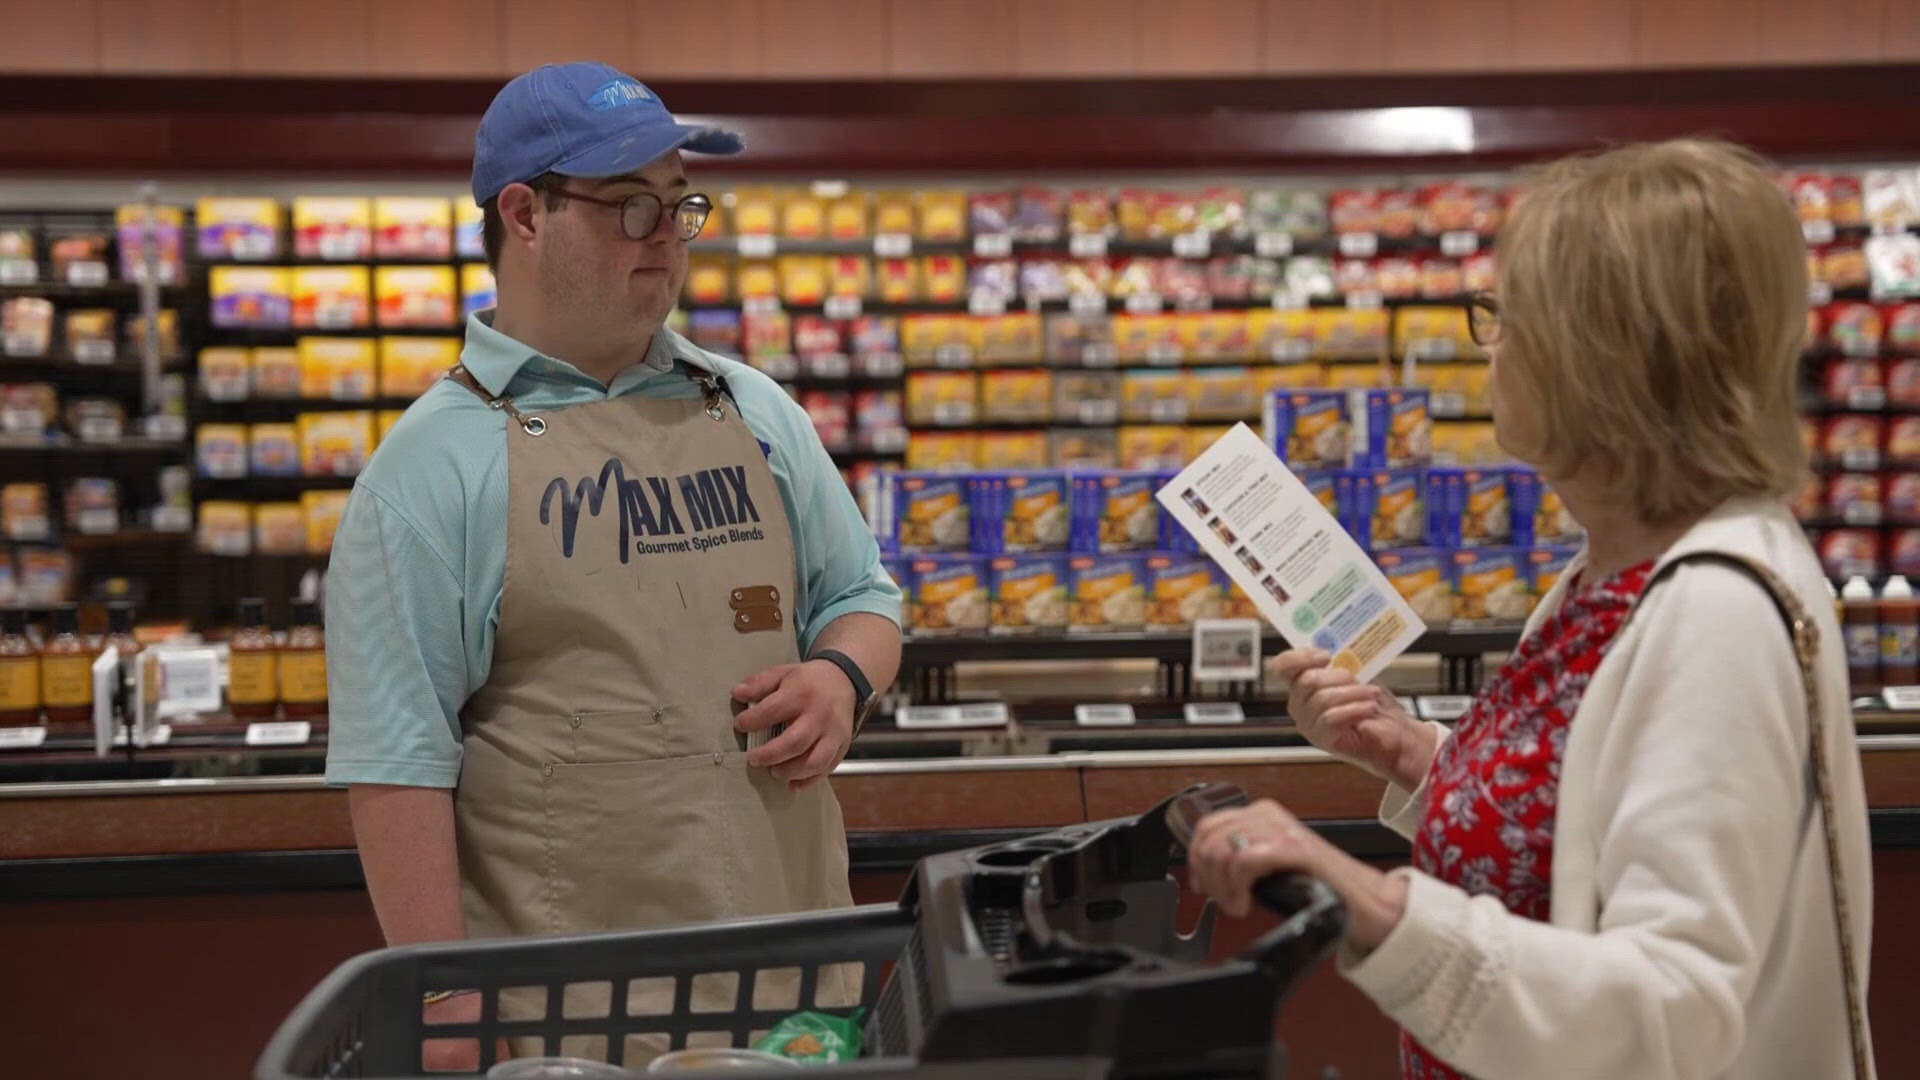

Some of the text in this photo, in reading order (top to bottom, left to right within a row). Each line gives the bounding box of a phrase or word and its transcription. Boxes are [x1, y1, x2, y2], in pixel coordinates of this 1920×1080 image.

[539, 457, 761, 564] MAX MIX
[636, 527, 765, 555] Gourmet Spice Blends
